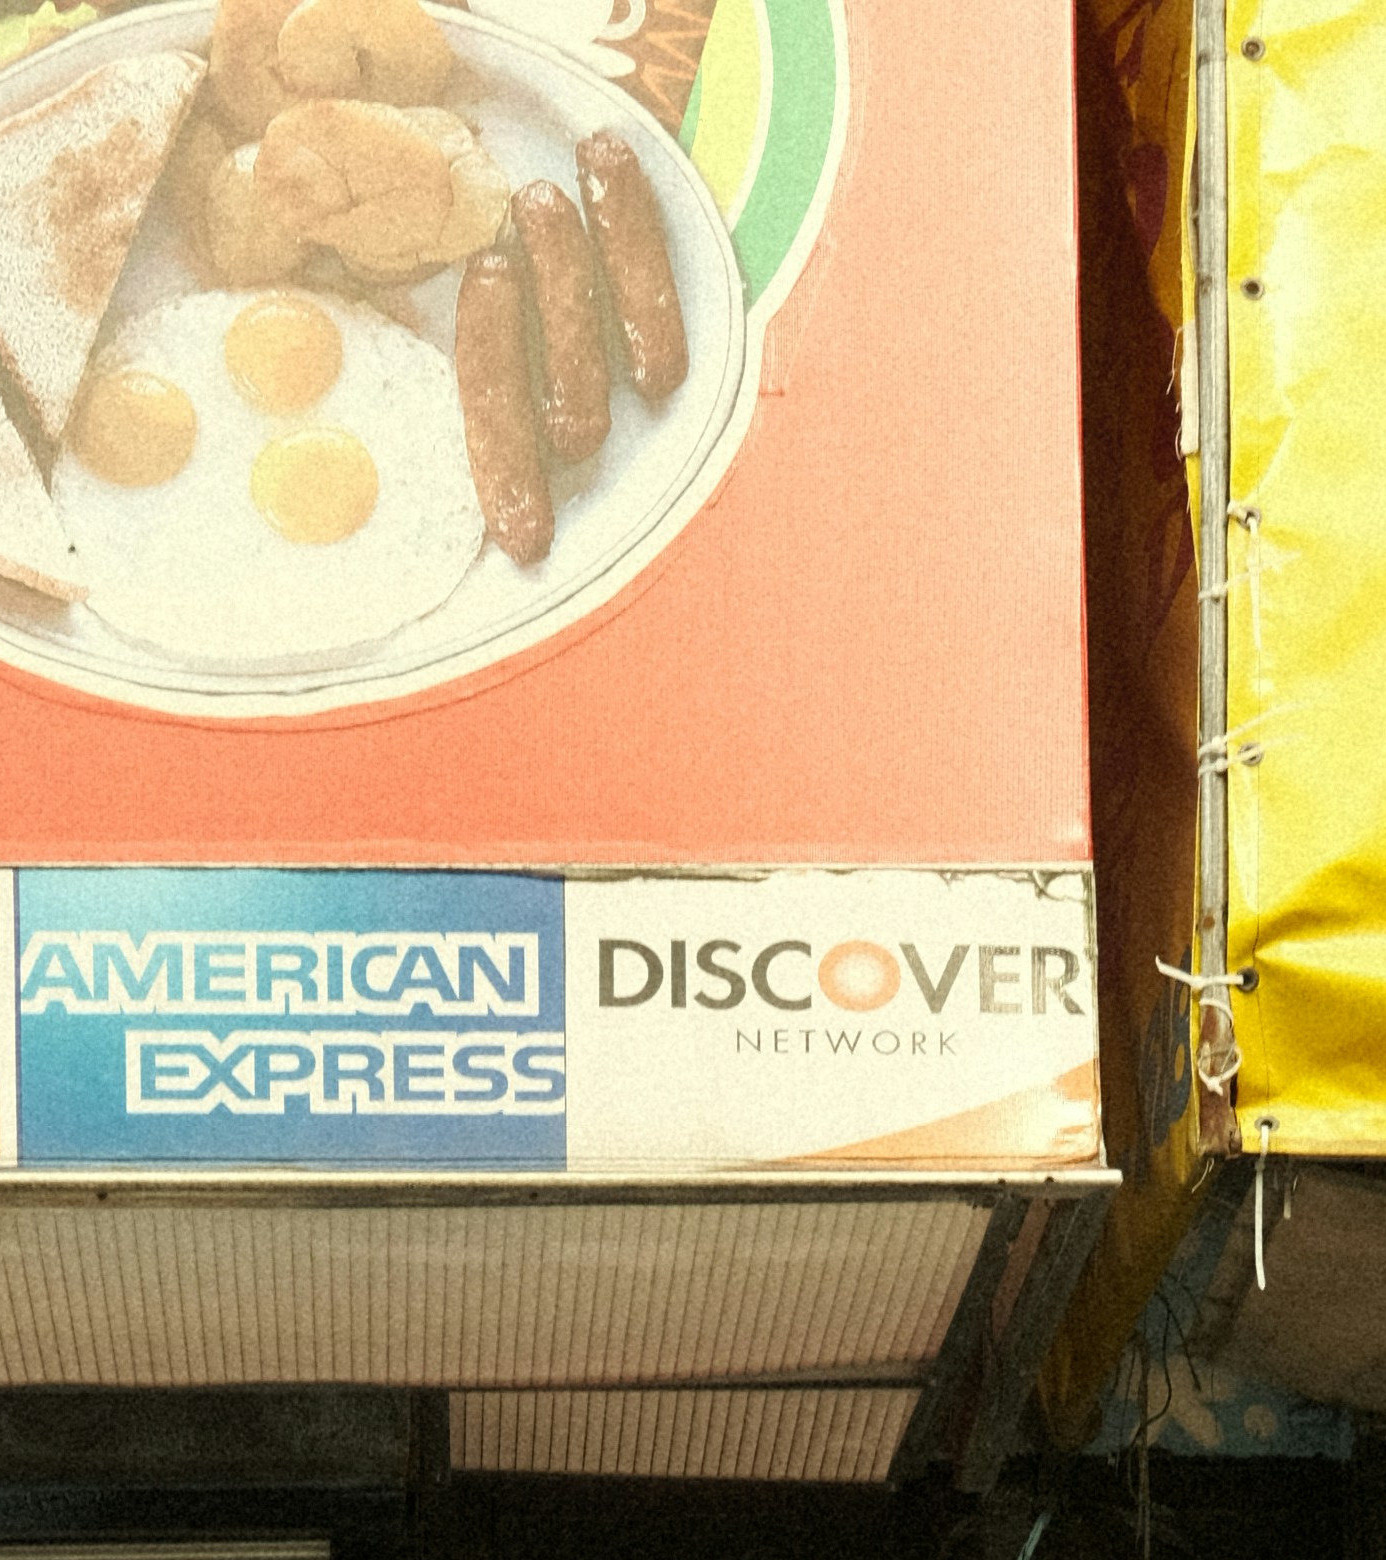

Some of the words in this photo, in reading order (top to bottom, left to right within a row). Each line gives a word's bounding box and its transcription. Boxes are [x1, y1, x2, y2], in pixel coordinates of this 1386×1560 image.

[19, 930, 540, 1015] AMERICAN
[597, 938, 1087, 1018] DISCOVER
[125, 1029, 567, 1115] EXPRESS
[735, 1027, 960, 1056] NETWORK
